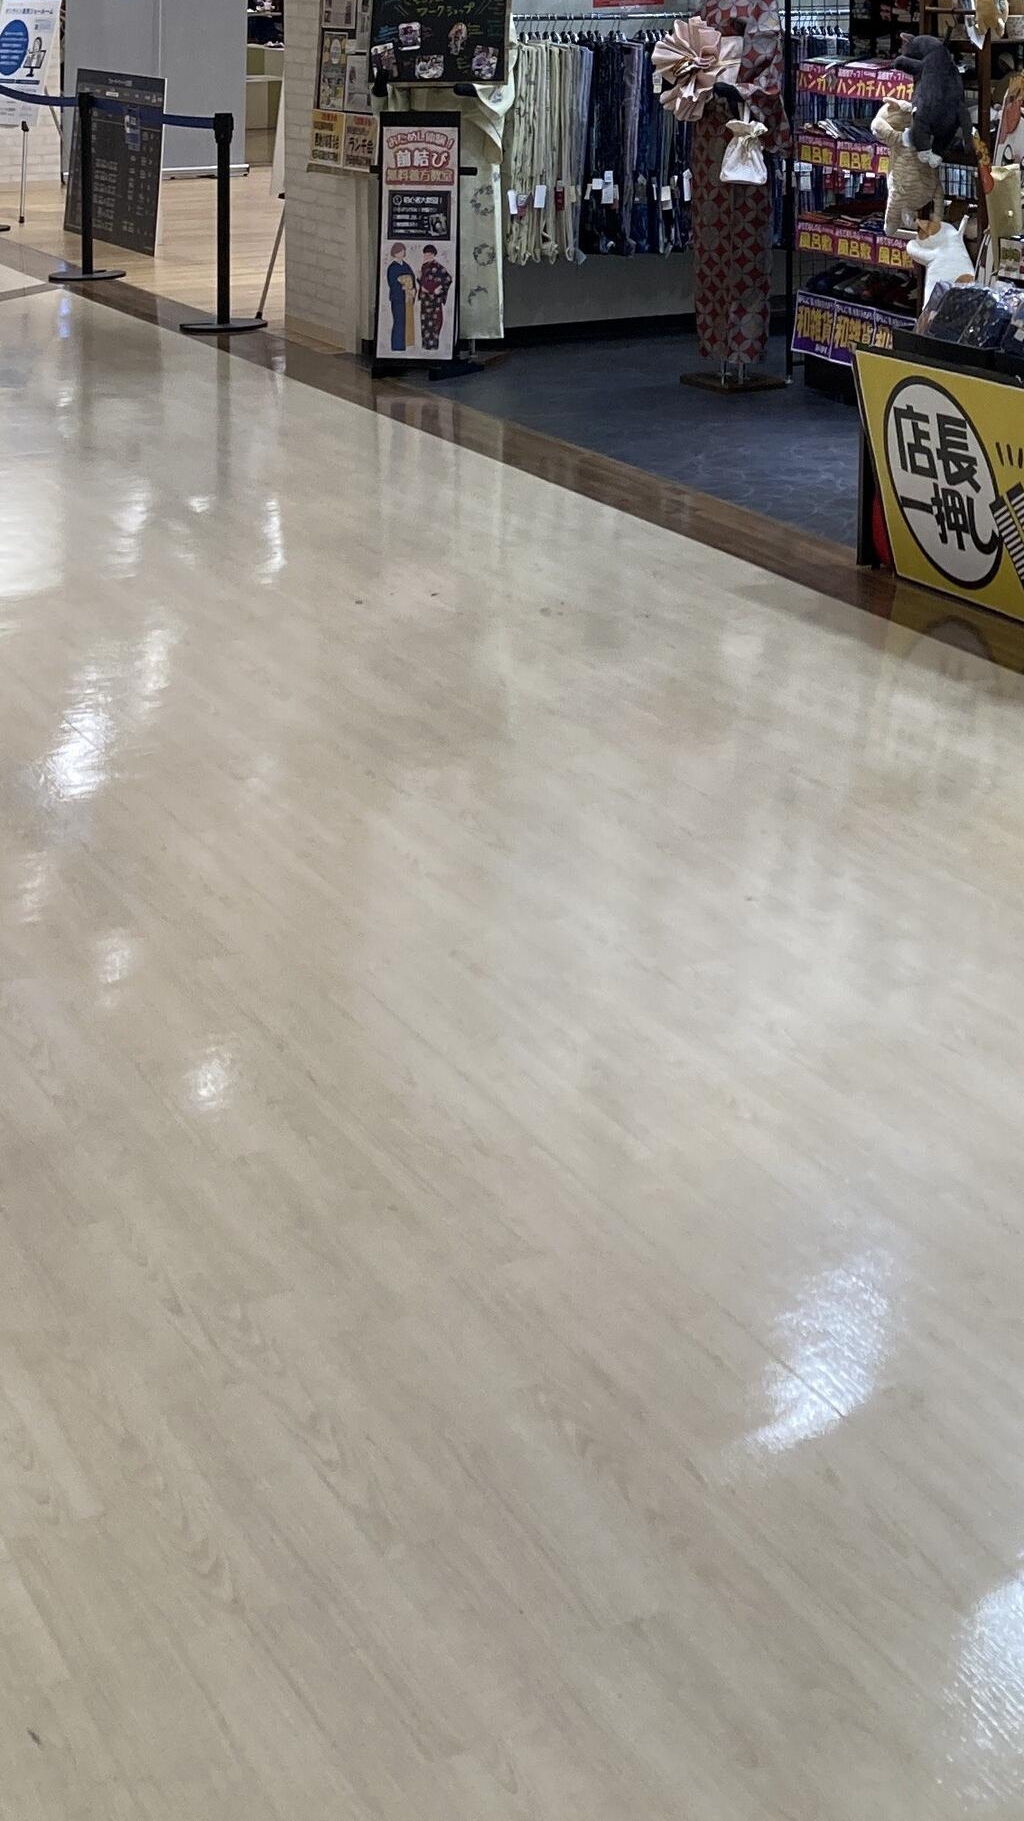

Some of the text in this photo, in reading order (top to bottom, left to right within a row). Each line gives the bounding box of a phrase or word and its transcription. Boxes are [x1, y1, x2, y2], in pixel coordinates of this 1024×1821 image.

[417, 1, 476, 17] ワークショップ
[800, 71, 914, 100] ハンカ ハンカチ ハンカチ
[396, 148, 450, 168] 前結び
[893, 404, 981, 493] 店長
[901, 482, 999, 556] 一押し
